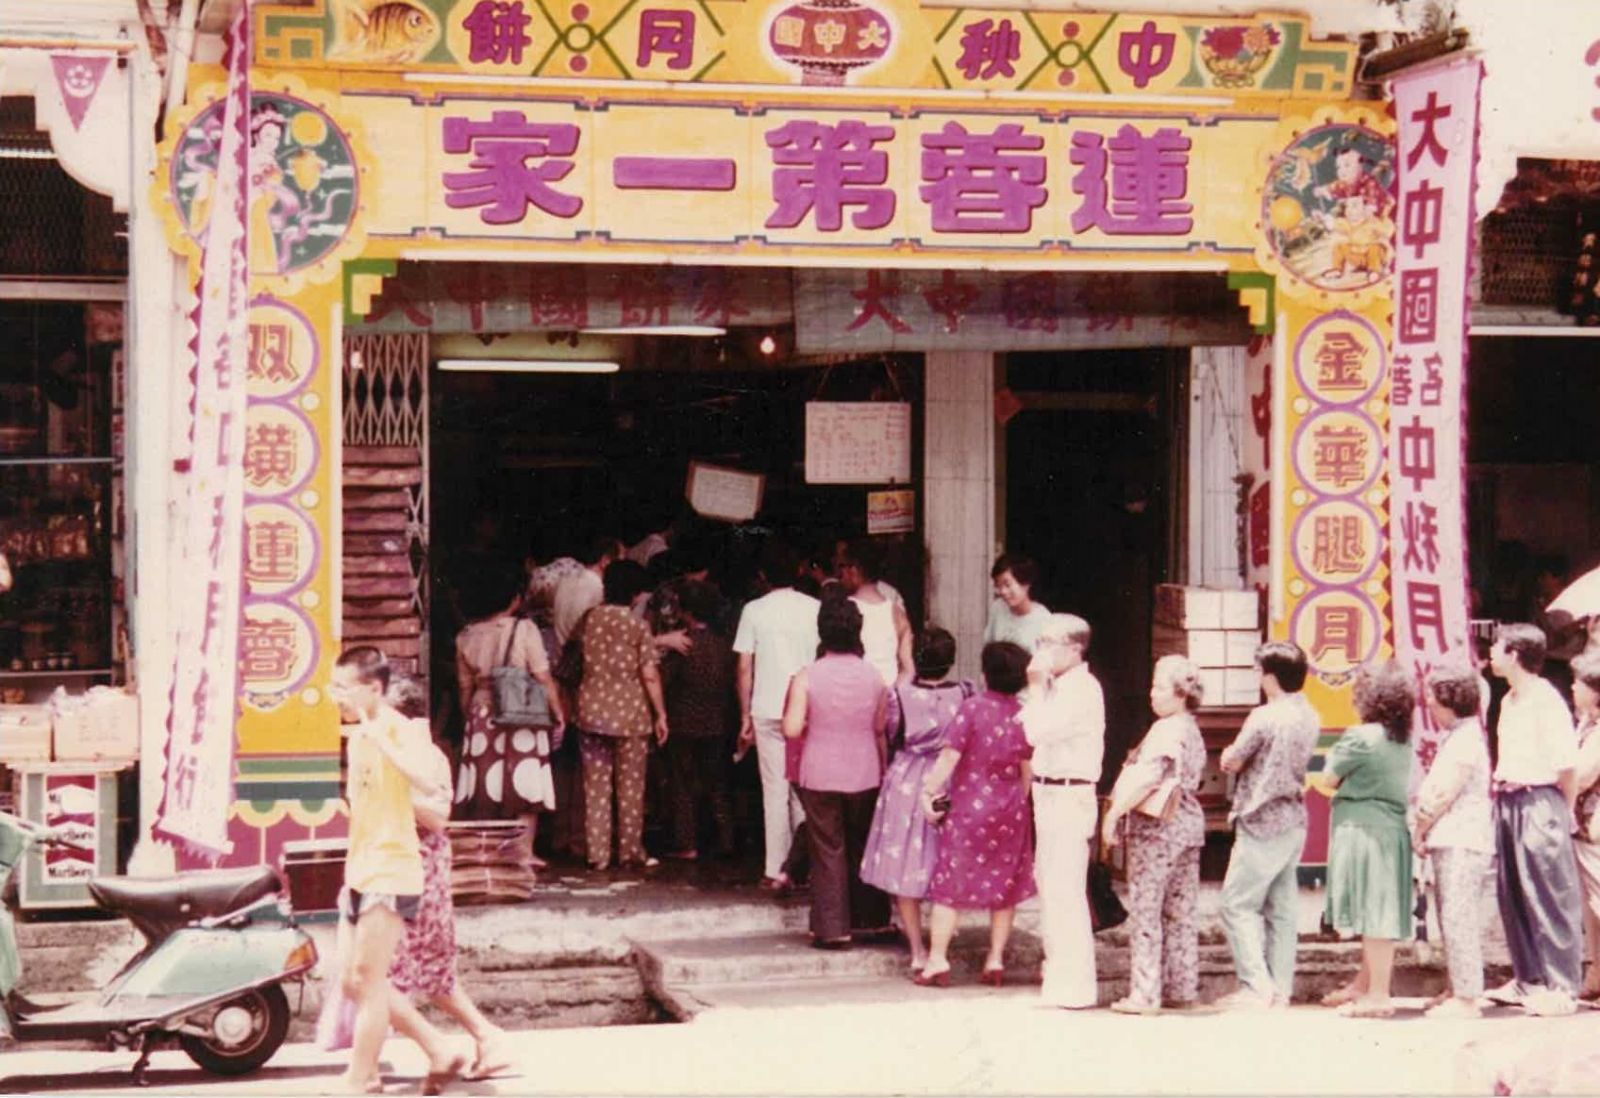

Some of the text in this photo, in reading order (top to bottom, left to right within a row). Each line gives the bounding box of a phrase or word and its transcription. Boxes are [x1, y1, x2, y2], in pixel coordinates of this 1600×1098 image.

[442, 111, 1194, 235] 蓮蓉第一家
[1313, 332, 1368, 663] 金華腿月
